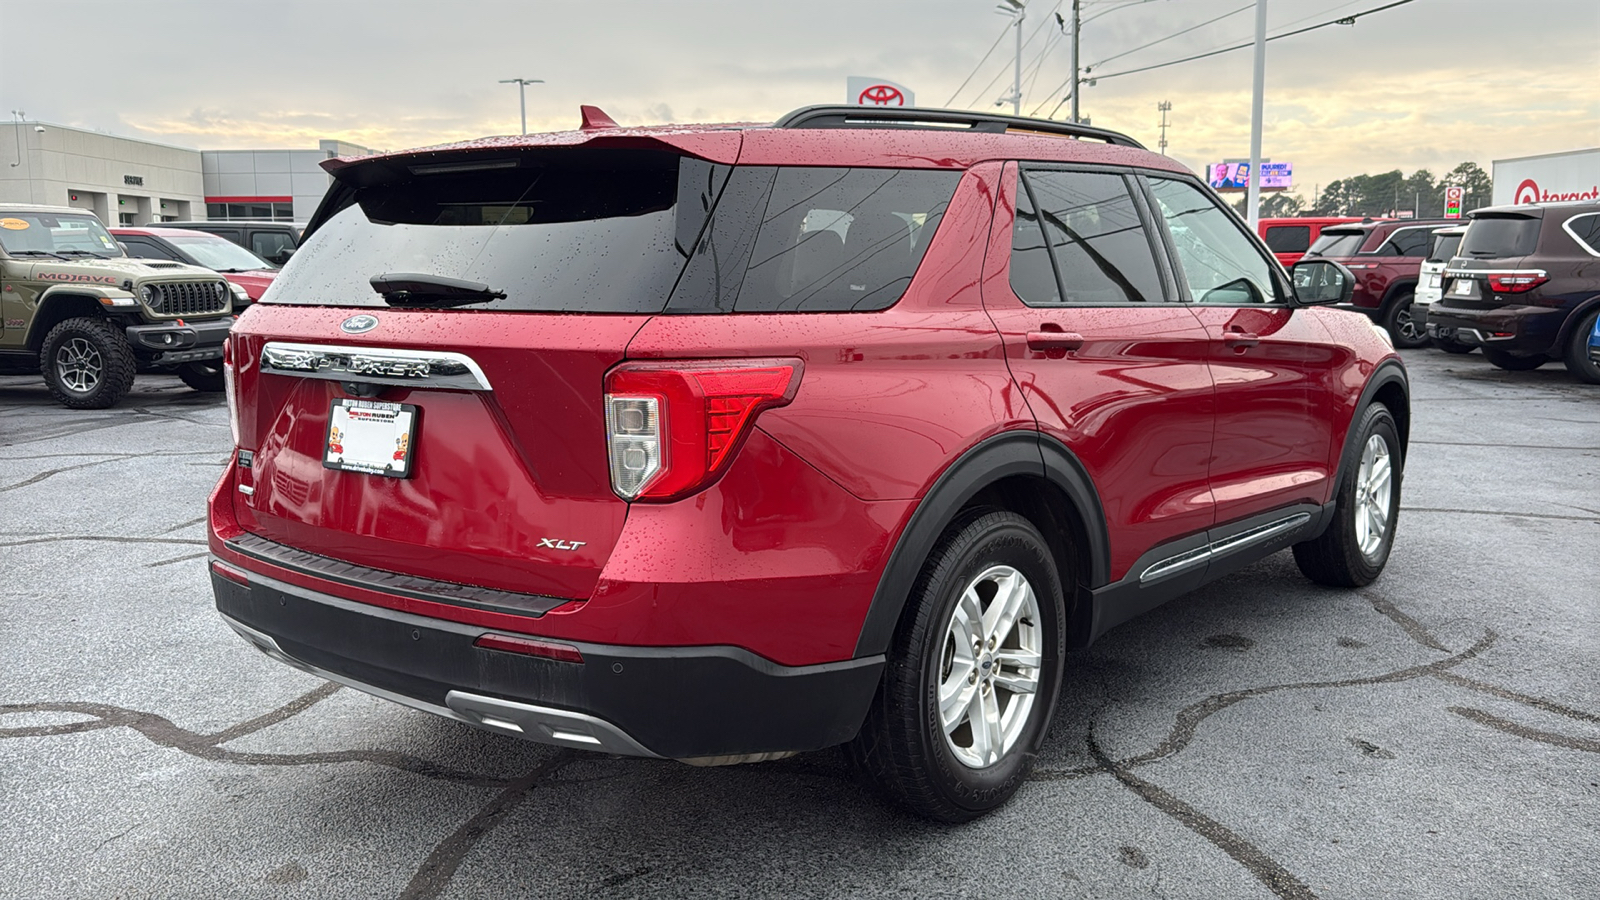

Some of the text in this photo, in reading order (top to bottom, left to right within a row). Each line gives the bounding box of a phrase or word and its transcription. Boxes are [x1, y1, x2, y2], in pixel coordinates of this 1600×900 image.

[38, 272, 116, 283] MOJAVE
[6, 318, 25, 326] Jeep
[346, 317, 371, 329] Ford
[281, 354, 430, 378] EXPLORER
[358, 400, 373, 409] RUBEN
[373, 401, 402, 411] SUPERSTORE
[535, 537, 587, 551] XLT
